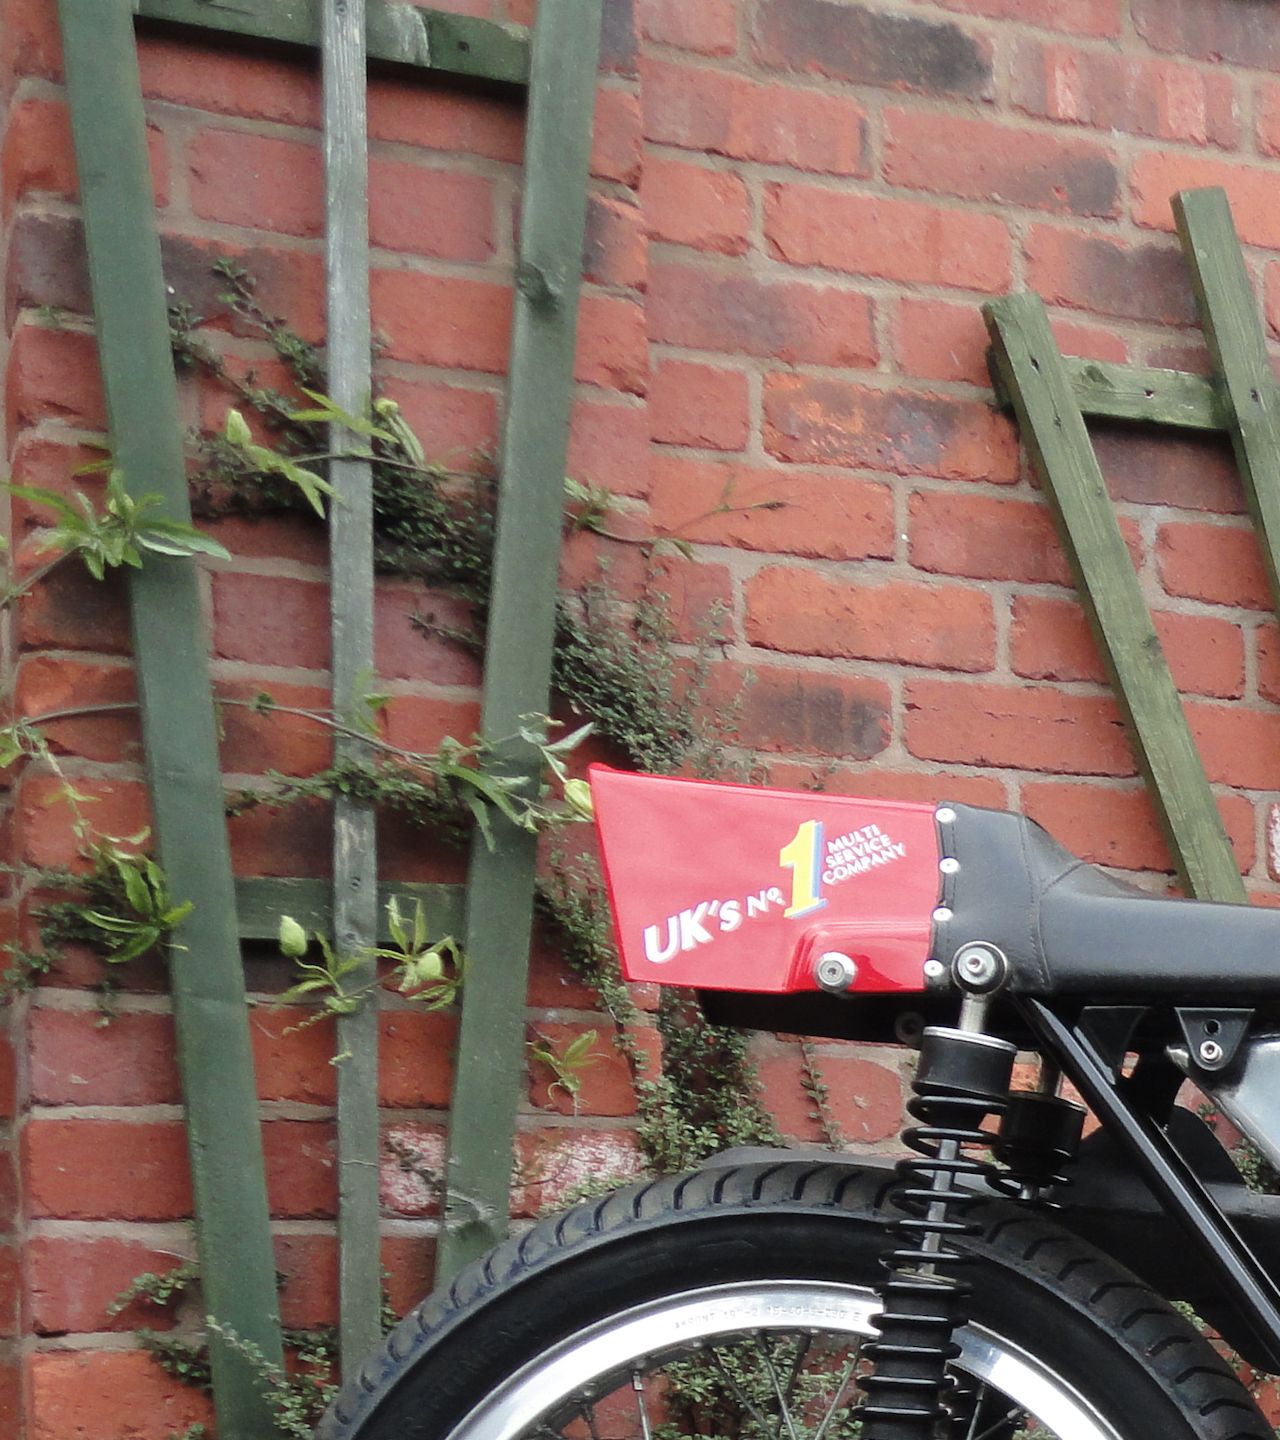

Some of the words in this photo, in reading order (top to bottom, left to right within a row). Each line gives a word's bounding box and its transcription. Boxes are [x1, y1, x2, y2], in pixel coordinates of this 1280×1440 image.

[825, 833, 893, 869] SERVICE
[826, 824, 881, 853] MULTI
[822, 842, 906, 885] COMPANY
[643, 900, 742, 963] UK'S
[779, 819, 828, 919] 1
